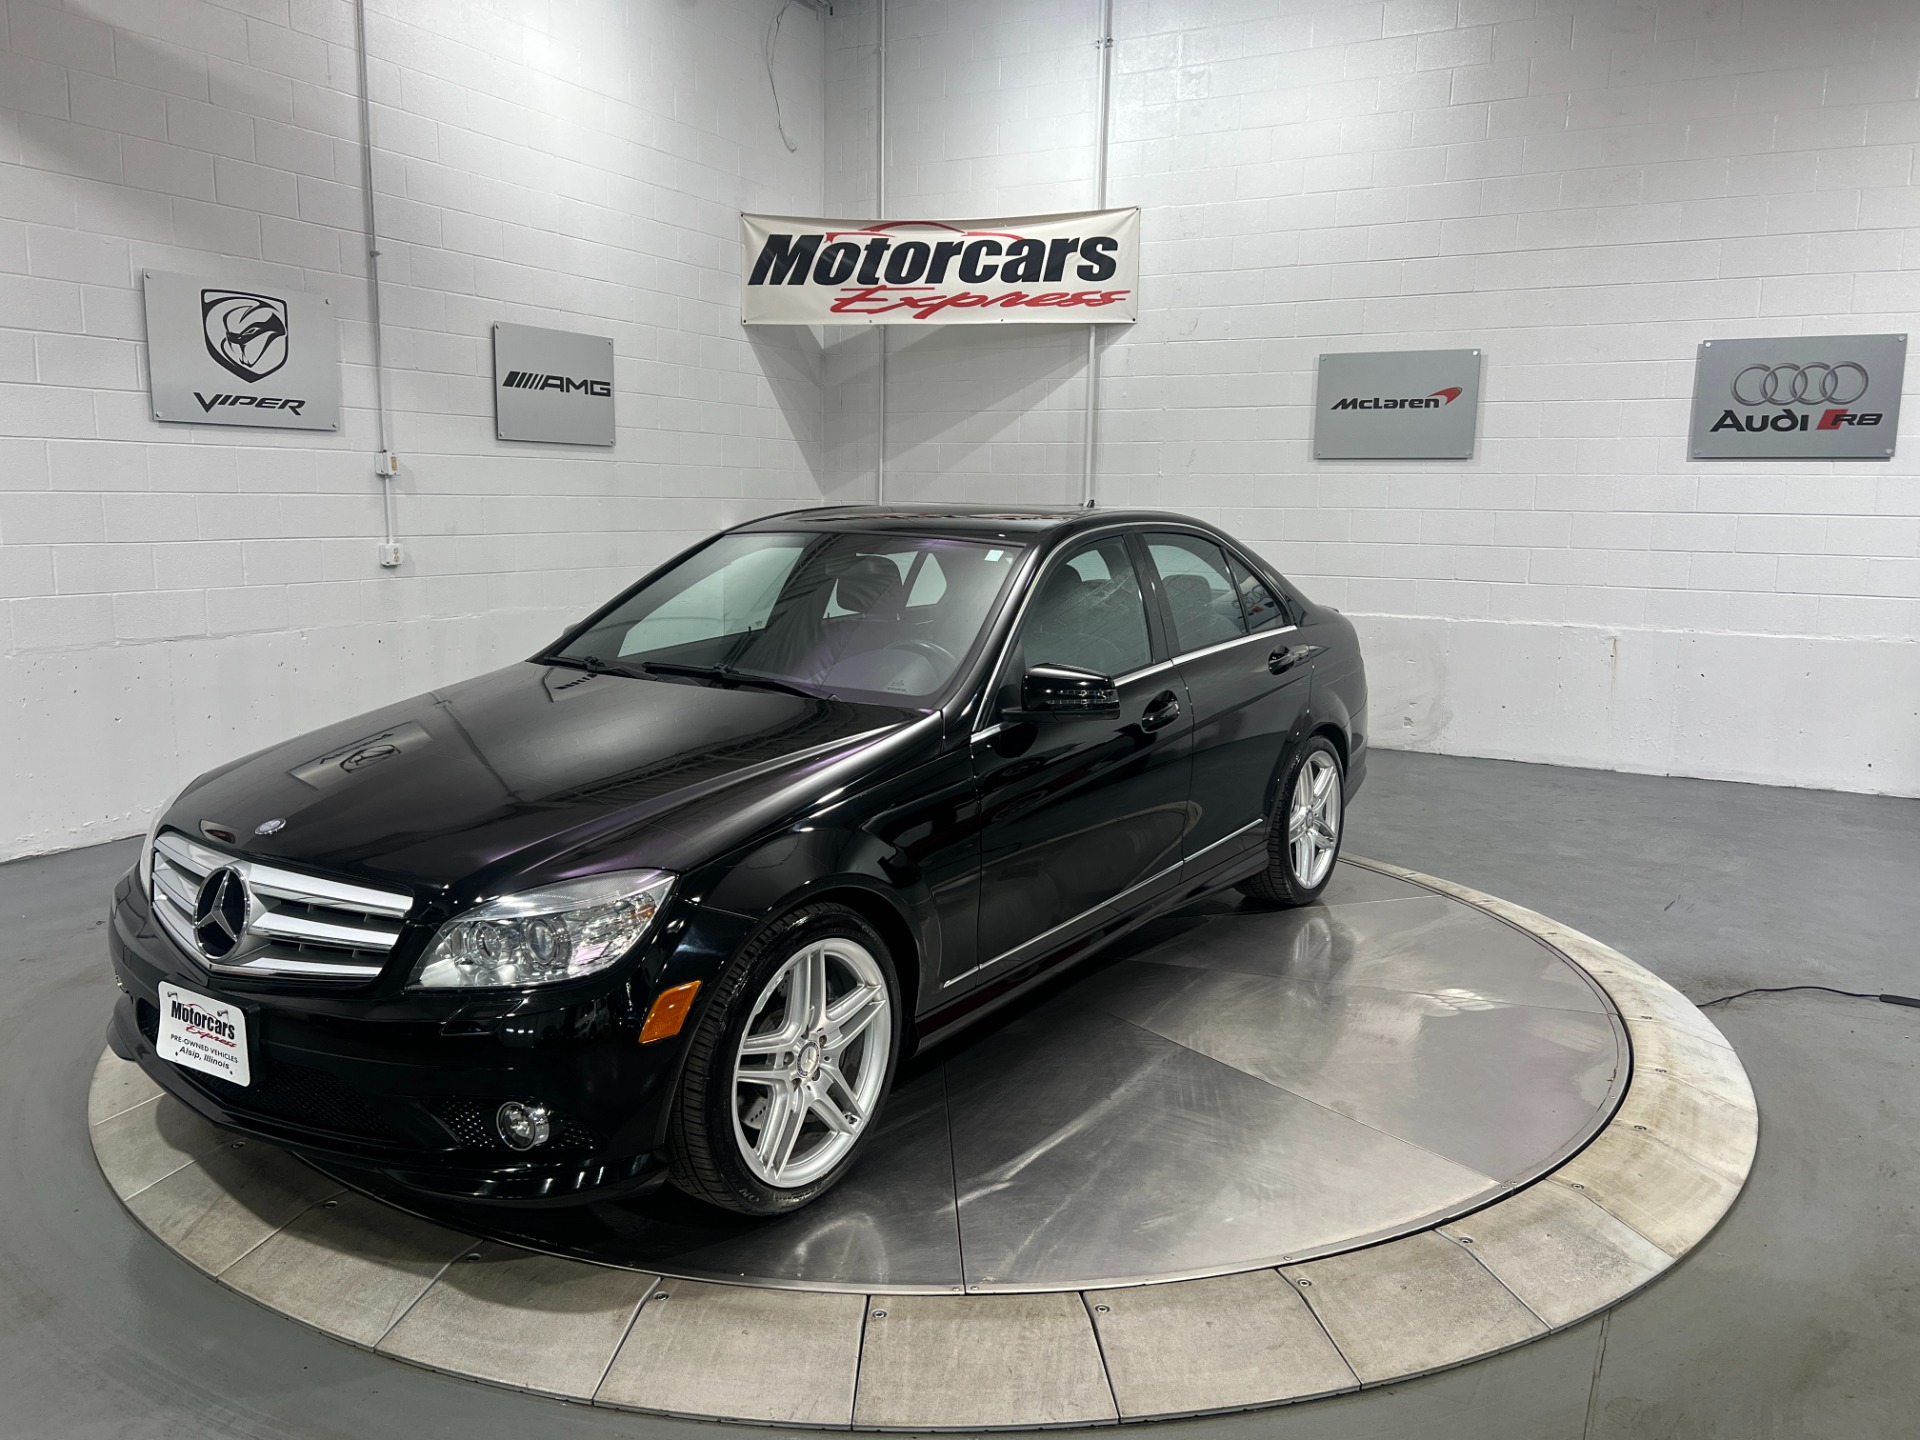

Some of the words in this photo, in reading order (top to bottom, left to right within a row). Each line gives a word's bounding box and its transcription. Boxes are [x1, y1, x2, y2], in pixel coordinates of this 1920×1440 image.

[748, 233, 1119, 286] Motorcars
[829, 285, 1131, 319] Express
[539, 374, 611, 397] AMG
[193, 392, 306, 416] VIPER
[1330, 398, 1440, 410] McLaren
[1709, 409, 1809, 432] Audi
[1831, 413, 1883, 426] R8
[171, 1000, 235, 1040] Motorcars
[186, 1024, 237, 1048] Express
[170, 1033, 209, 1052] PRE-OWNED
[210, 1047, 238, 1064] VEHICLES
[179, 1046, 202, 1061] Alsip,
[204, 1054, 230, 1070] Illinois
